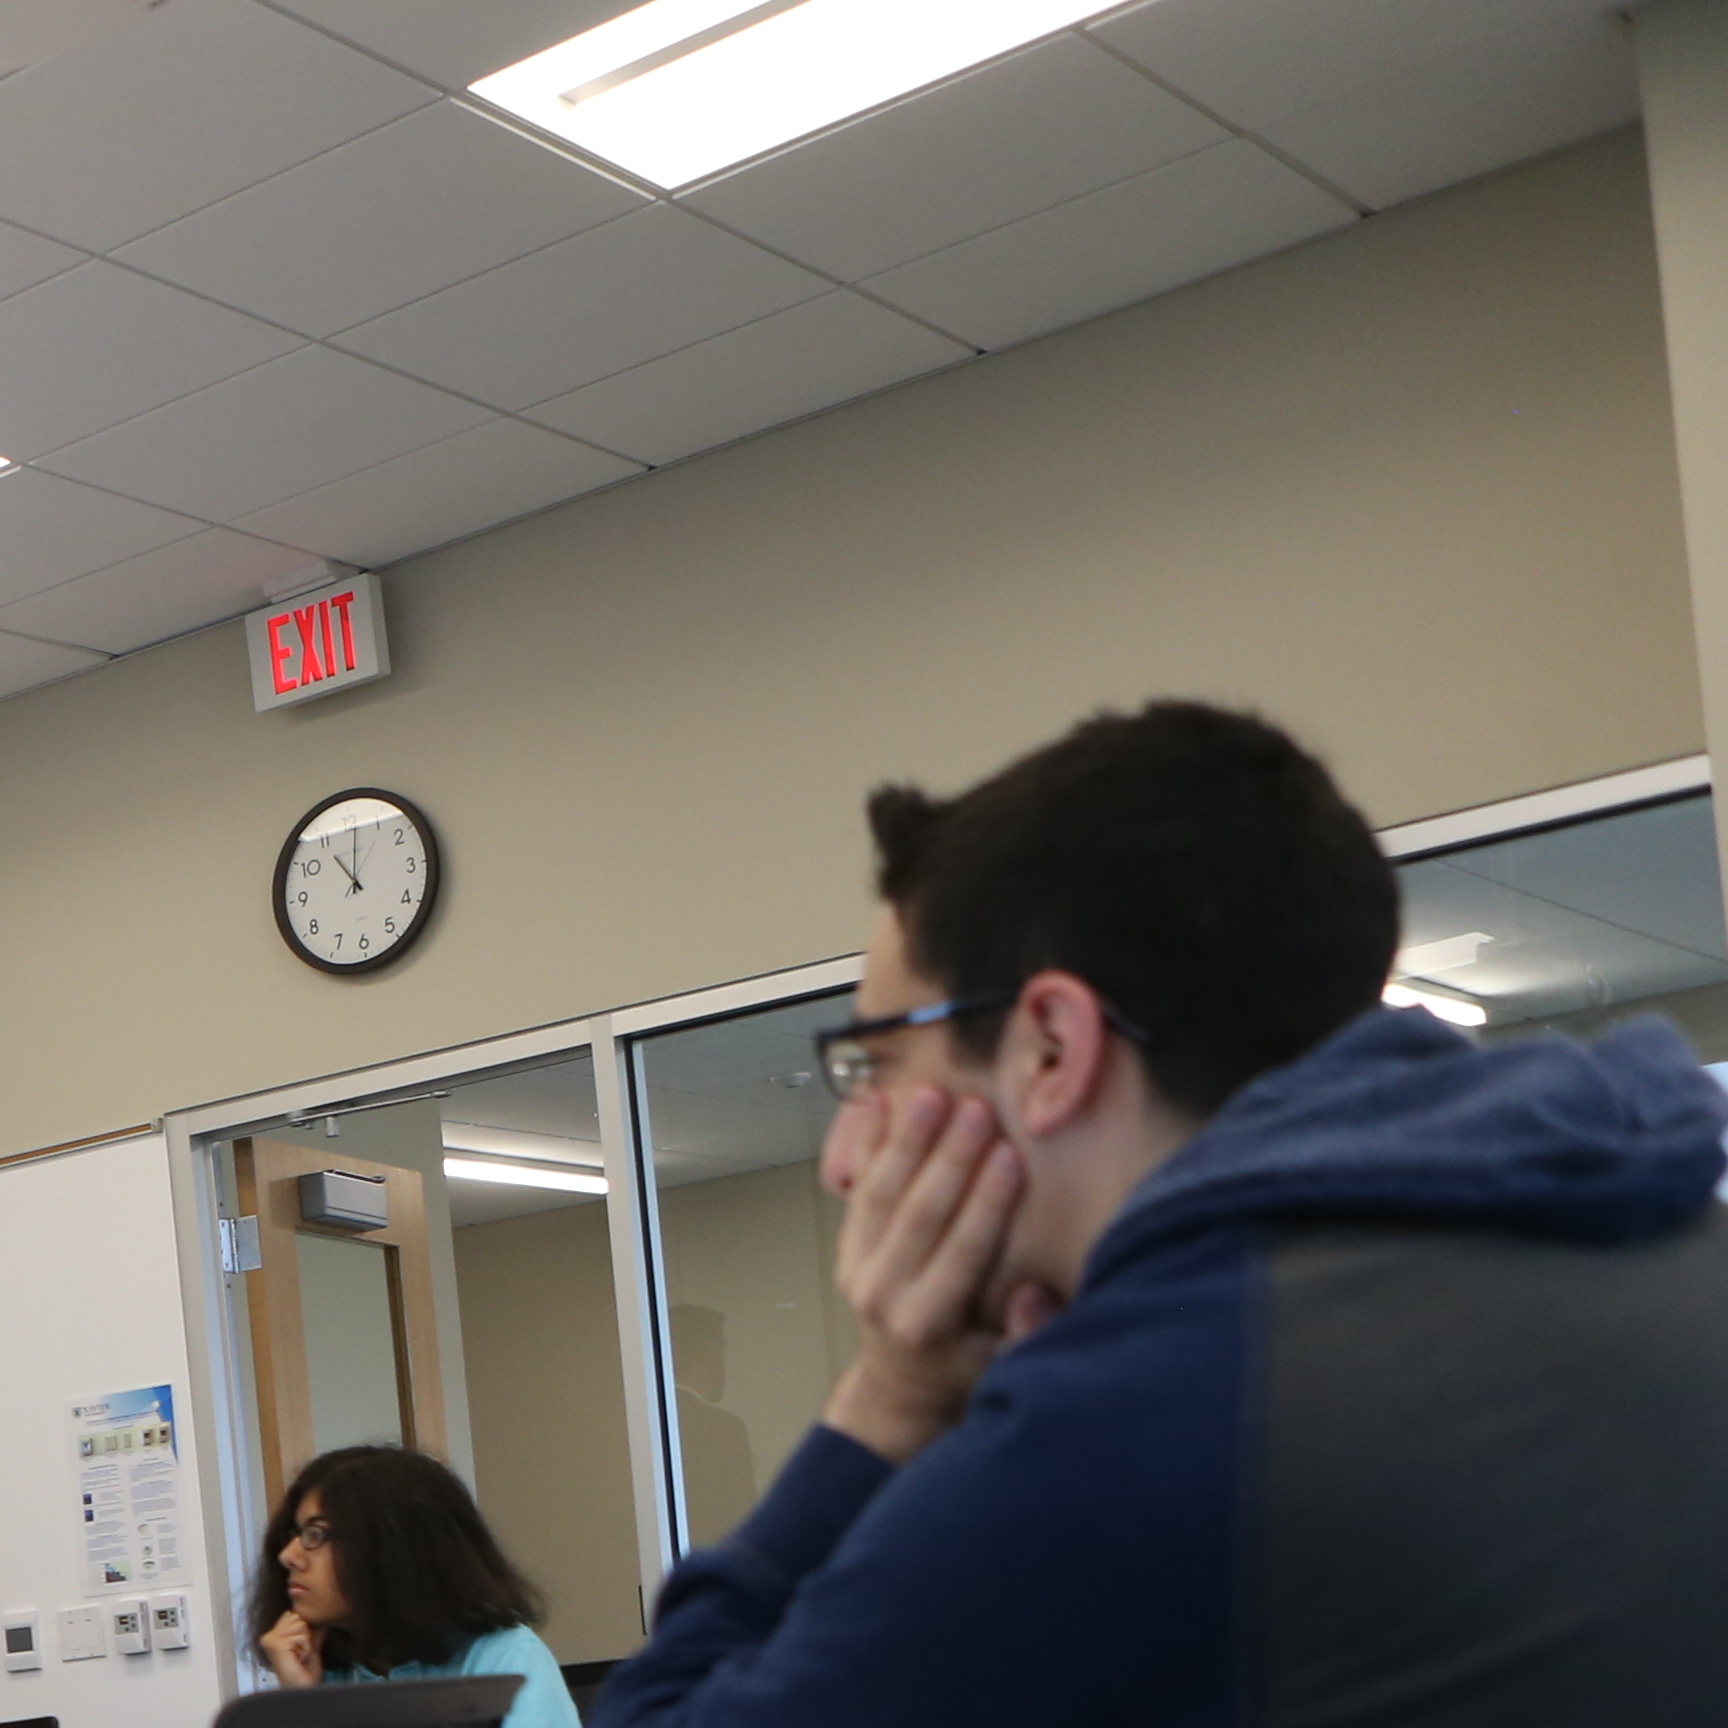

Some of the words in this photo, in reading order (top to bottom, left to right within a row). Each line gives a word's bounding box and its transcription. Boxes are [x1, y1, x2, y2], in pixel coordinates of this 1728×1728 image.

[266, 591, 356, 695] EXIT
[393, 828, 405, 846] 2
[301, 859, 321, 878] 10
[405, 856, 416, 874] 3
[297, 890, 309, 908] 9
[400, 888, 412, 905] 4
[308, 918, 320, 935] 8
[384, 916, 396, 934] 5
[333, 933, 343, 950] 7
[358, 933, 369, 950] 6
